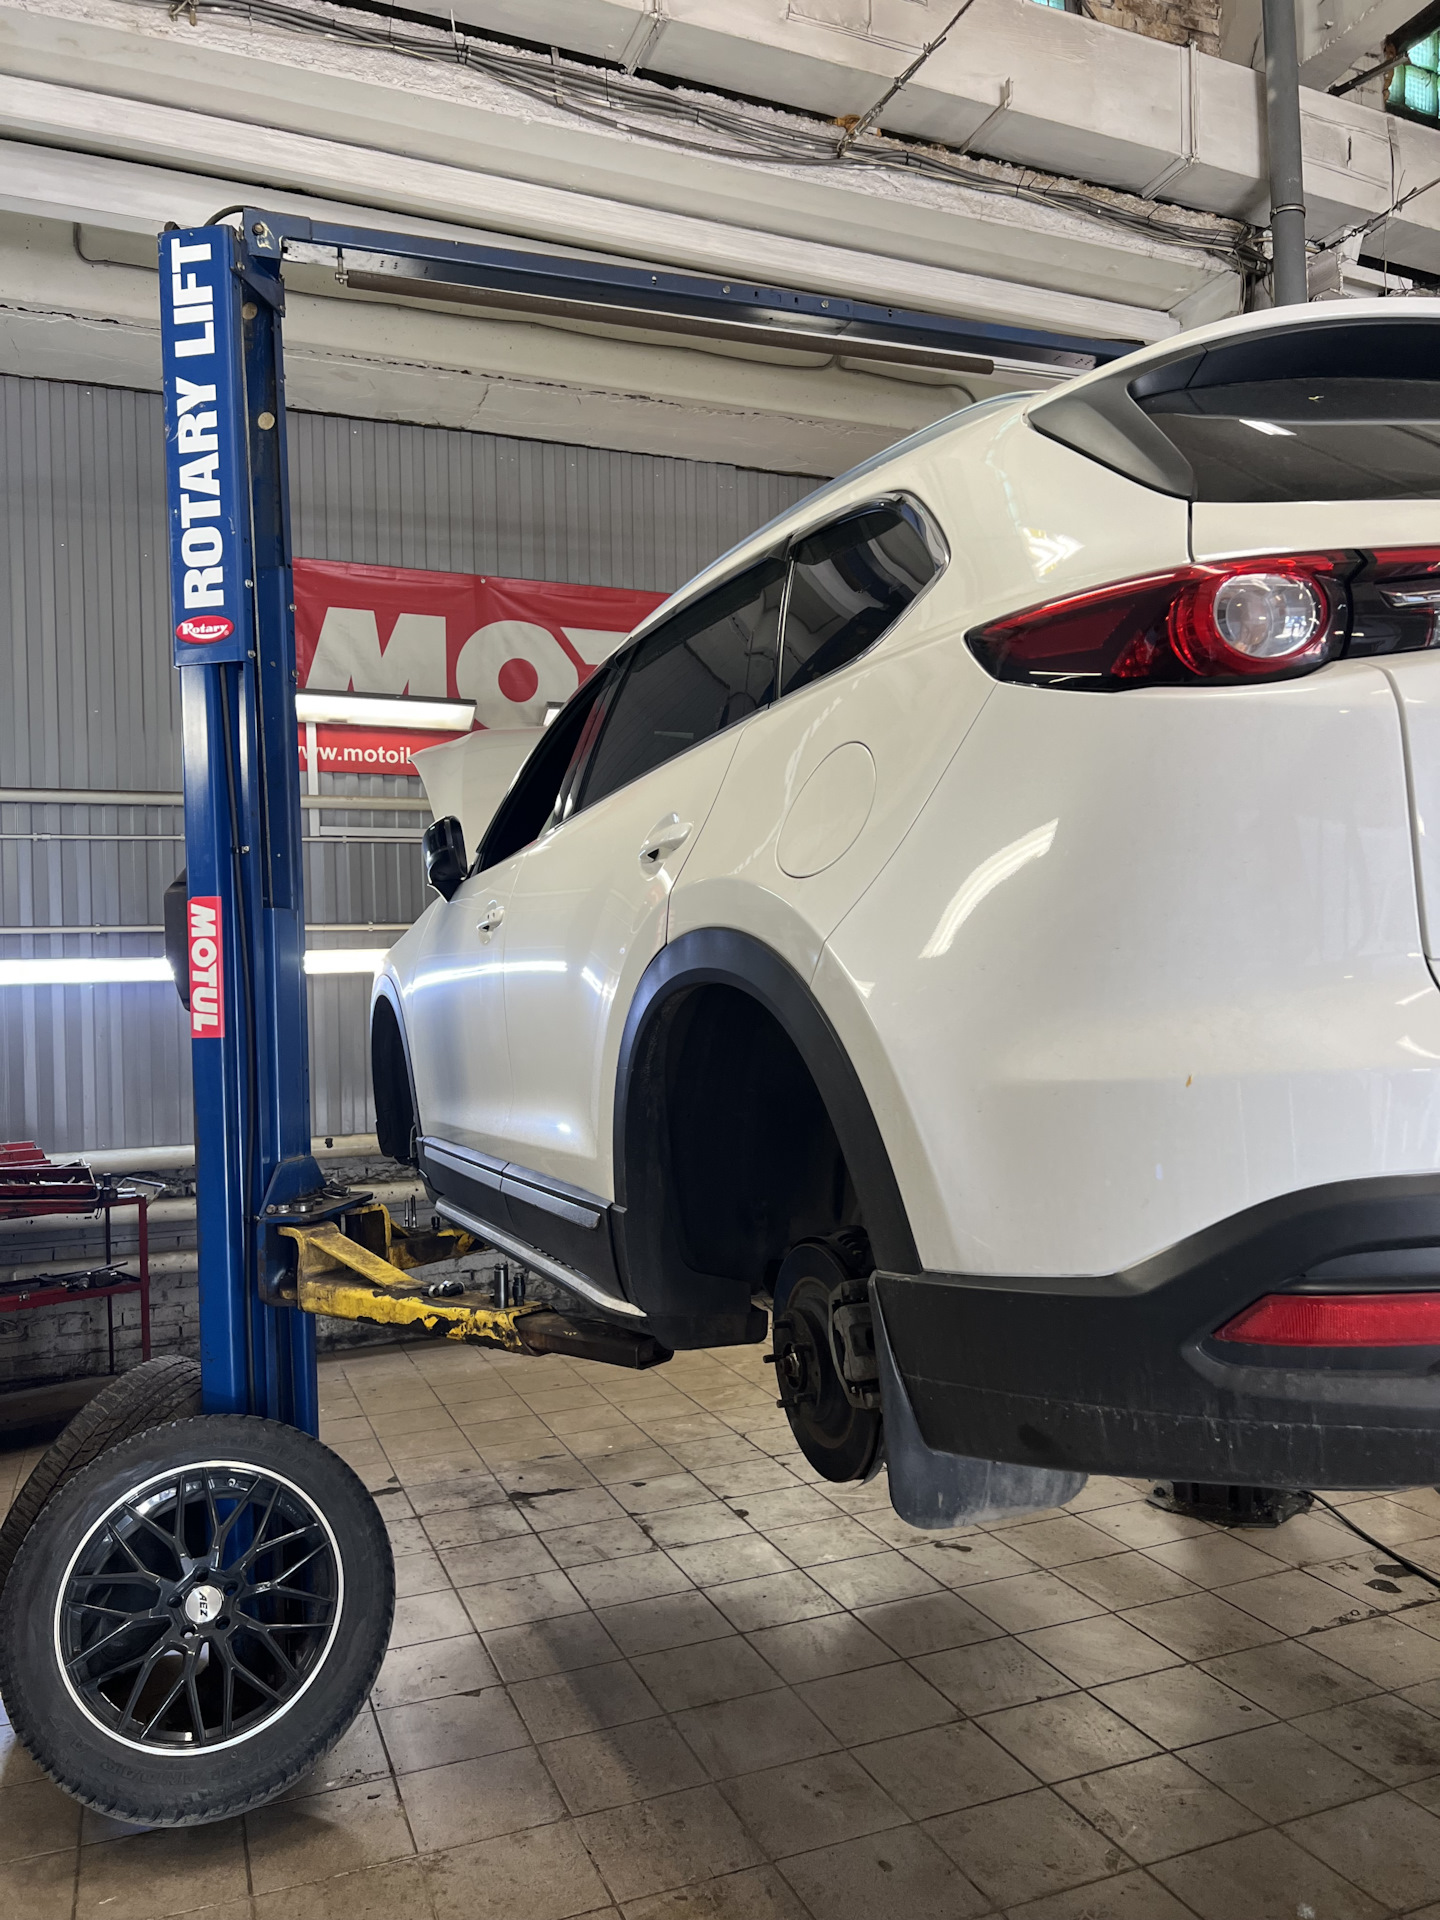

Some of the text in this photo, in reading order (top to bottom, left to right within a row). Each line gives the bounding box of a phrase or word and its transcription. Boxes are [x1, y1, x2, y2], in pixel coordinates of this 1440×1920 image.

[171, 238, 225, 609] ROTARY LIFT
[181, 622, 229, 639] Rotary
[298, 745, 411, 764] w.motoil
[190, 903, 218, 1032] MOTUL
[199, 1591, 208, 1617] AEZ
